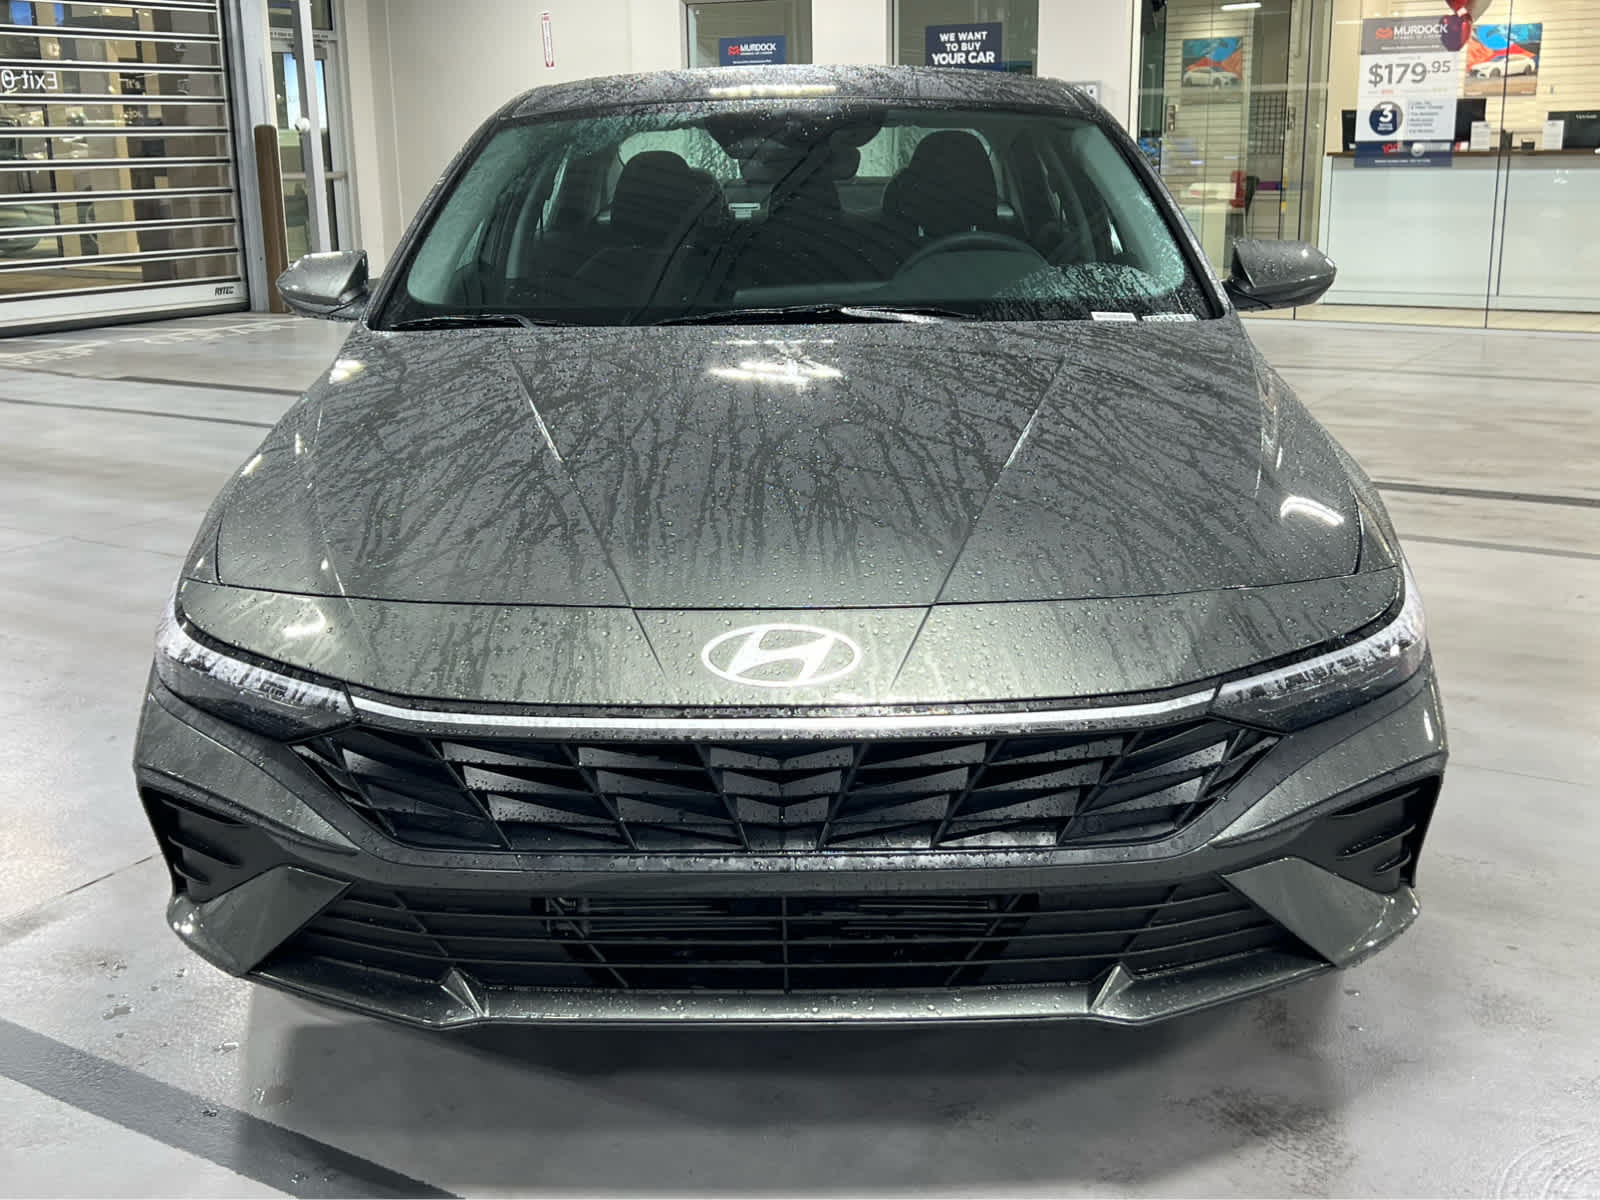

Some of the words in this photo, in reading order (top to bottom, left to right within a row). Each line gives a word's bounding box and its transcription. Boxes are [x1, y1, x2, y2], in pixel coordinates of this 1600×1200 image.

[1393, 24, 1448, 35] MURDOCK
[939, 32, 956, 42] WE
[958, 31, 988, 41] WANT
[945, 43, 959, 52] TO
[961, 41, 981, 51] BUY
[931, 52, 966, 65] YOUR
[968, 51, 995, 64] CAR
[1379, 104, 1393, 123] 3
